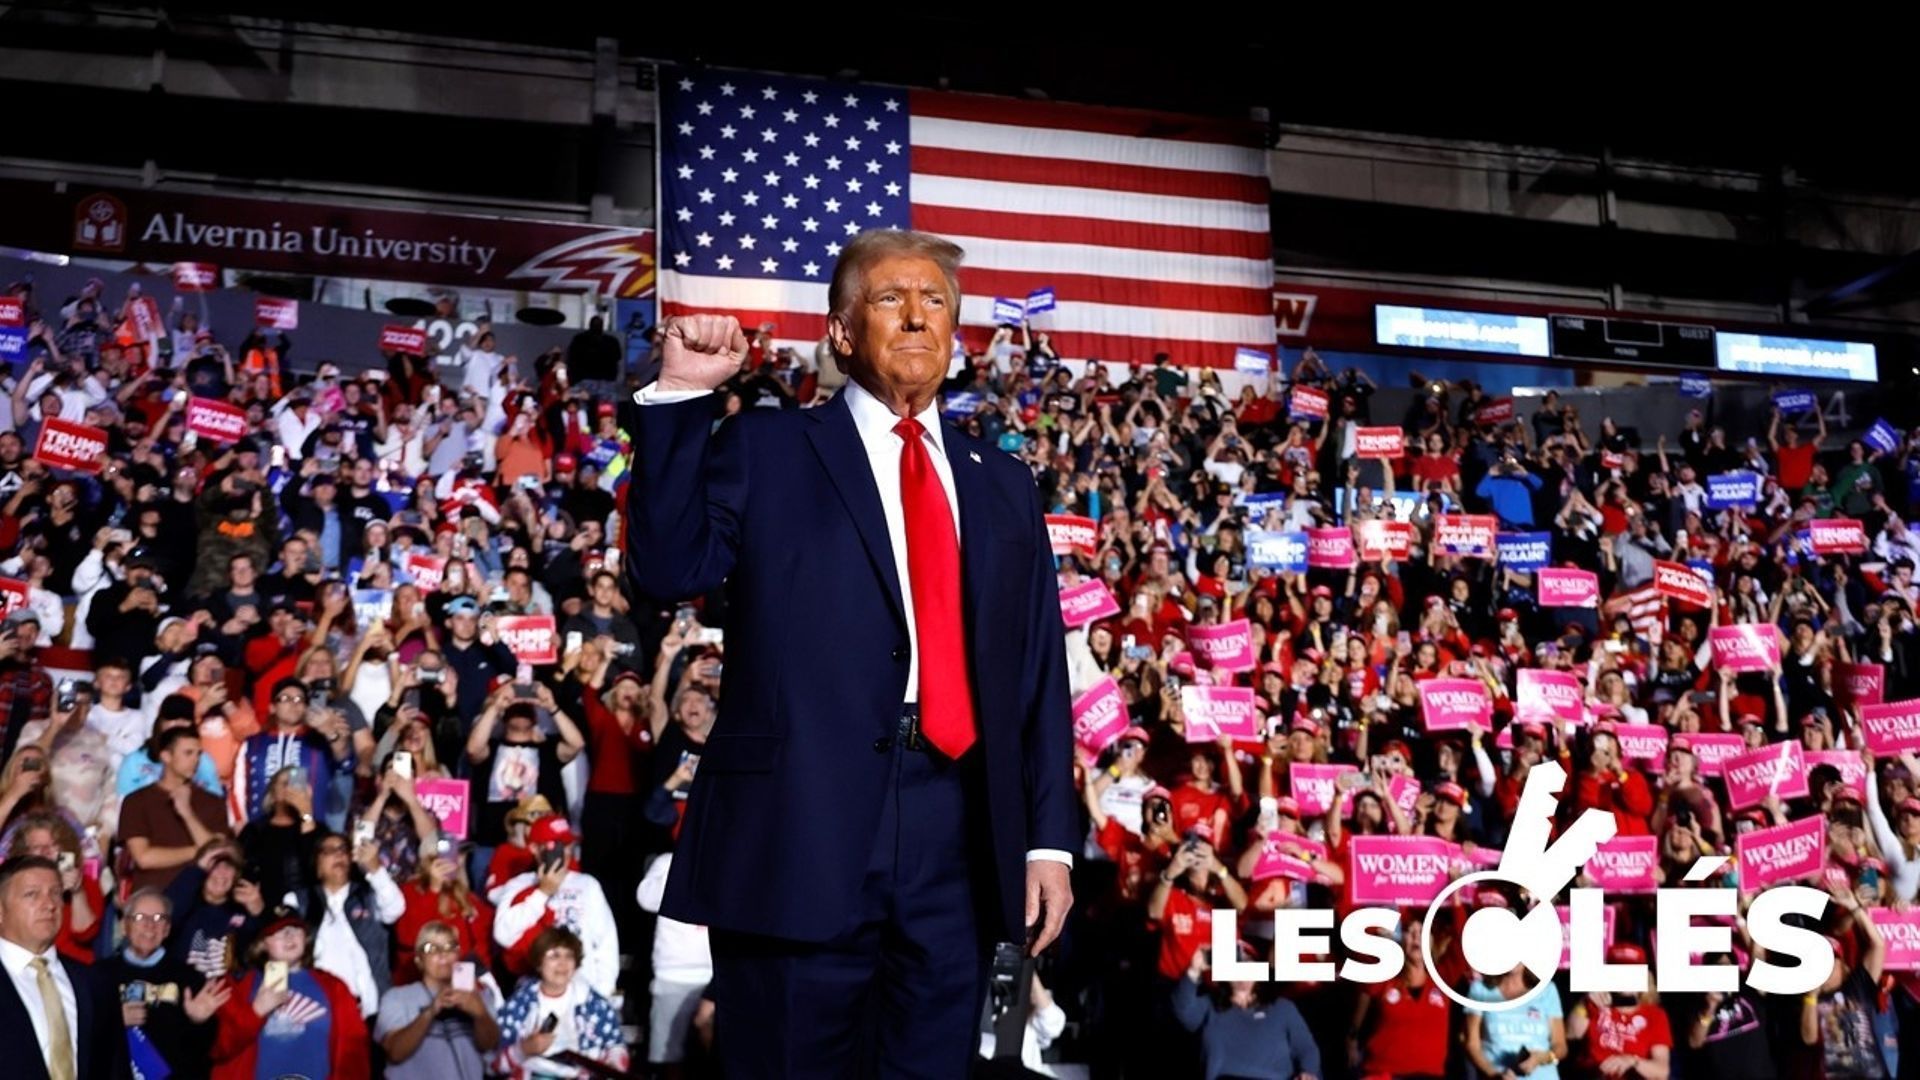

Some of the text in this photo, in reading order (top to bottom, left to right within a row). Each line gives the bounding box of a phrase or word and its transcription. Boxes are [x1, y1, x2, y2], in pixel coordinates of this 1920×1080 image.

[142, 213, 496, 274] Alvernia University
[1679, 327, 1710, 340] GUEST
[45, 428, 105, 454] TRUMP
[1542, 577, 1595, 590] WOMEN
[1427, 691, 1486, 708] WOMEN
[1866, 713, 1920, 735] WOM
[1691, 743, 1742, 758] OMEN
[417, 794, 466, 813] MEN
[1744, 832, 1820, 867] WOMEN
[1357, 853, 1448, 875] WOMEN
[1592, 850, 1653, 869] WOMEN
[1374, 873, 1436, 888] for TRUMP
[1875, 923, 1920, 941] WOM
